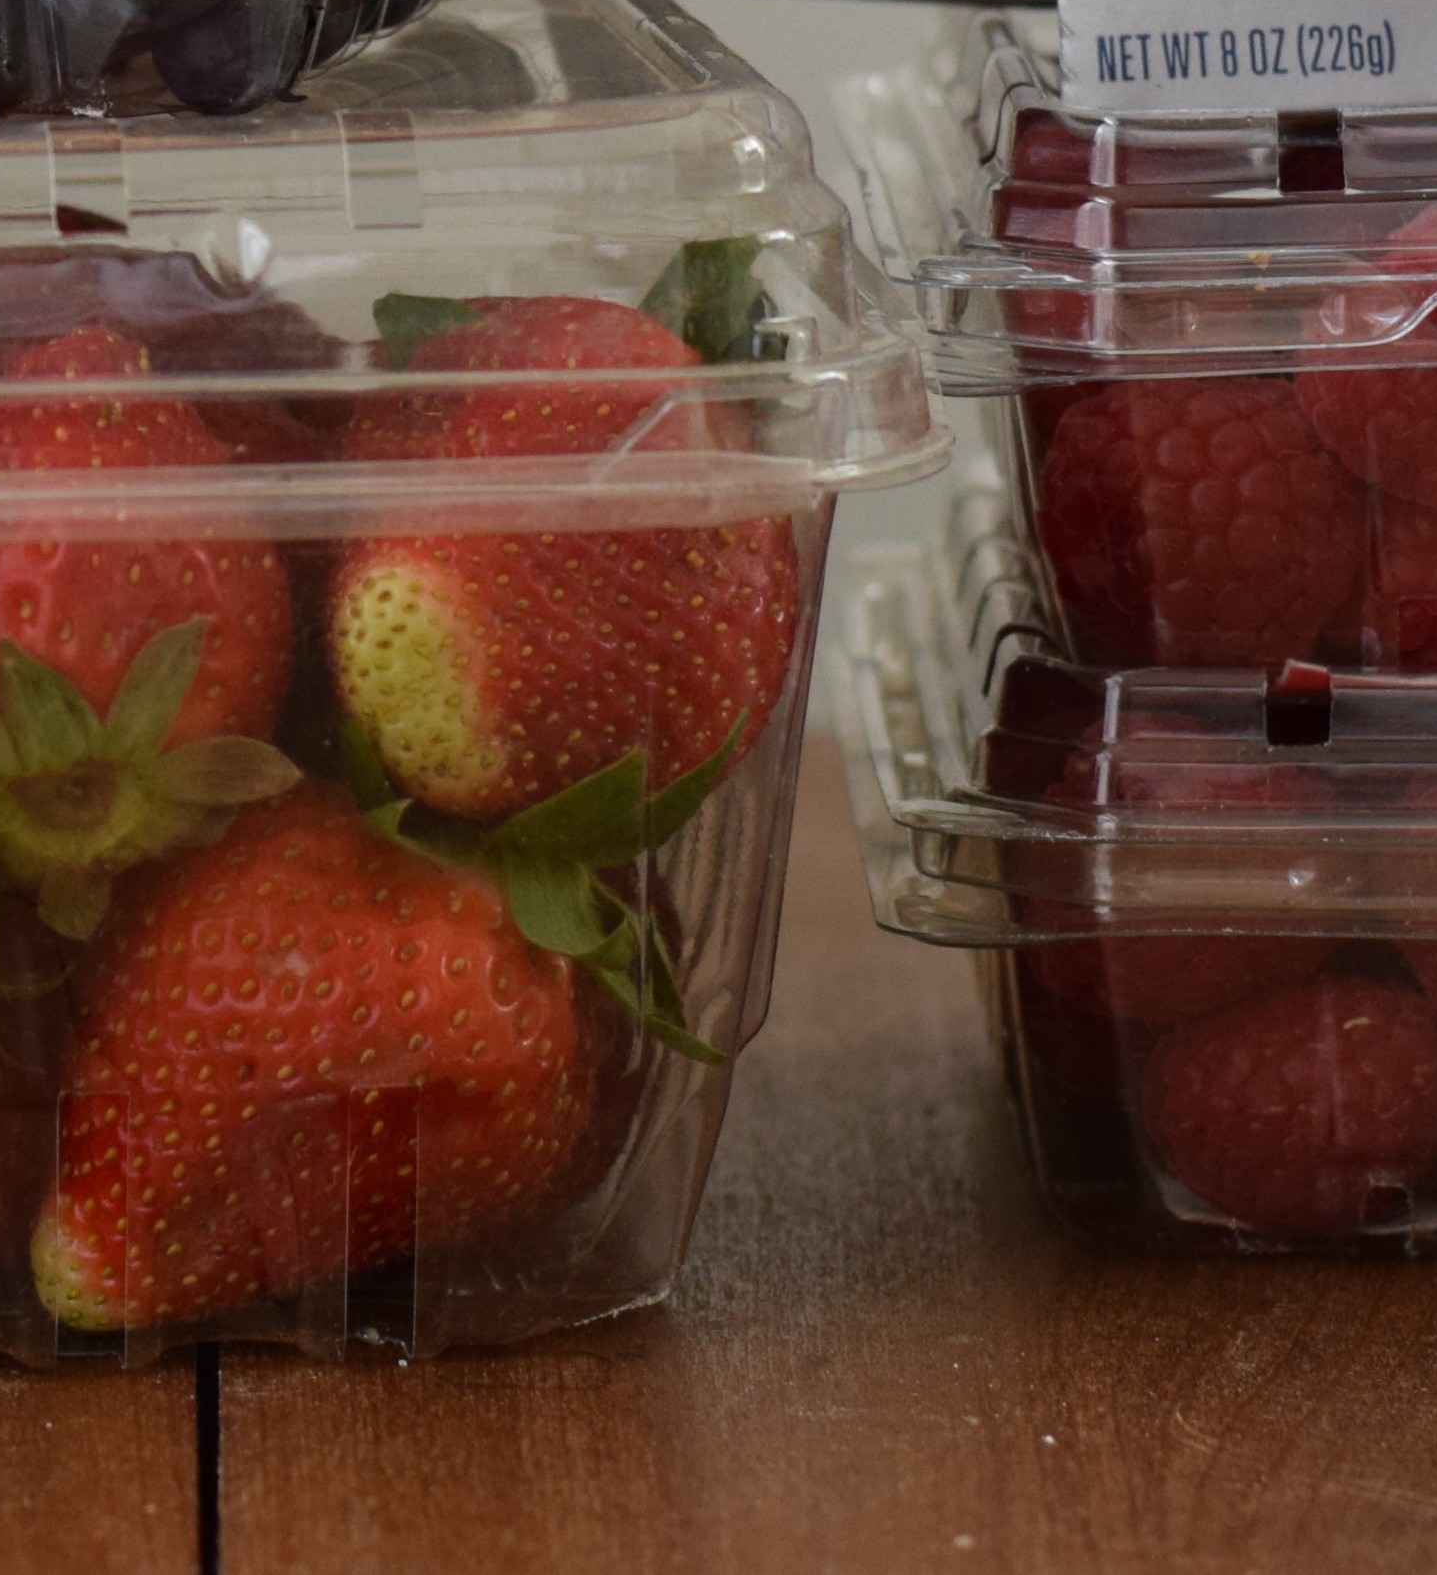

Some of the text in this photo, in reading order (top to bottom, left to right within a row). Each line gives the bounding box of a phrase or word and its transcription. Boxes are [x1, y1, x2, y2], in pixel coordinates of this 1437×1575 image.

[1096, 19, 1397, 83] NET WT 8 OZ (226g)
